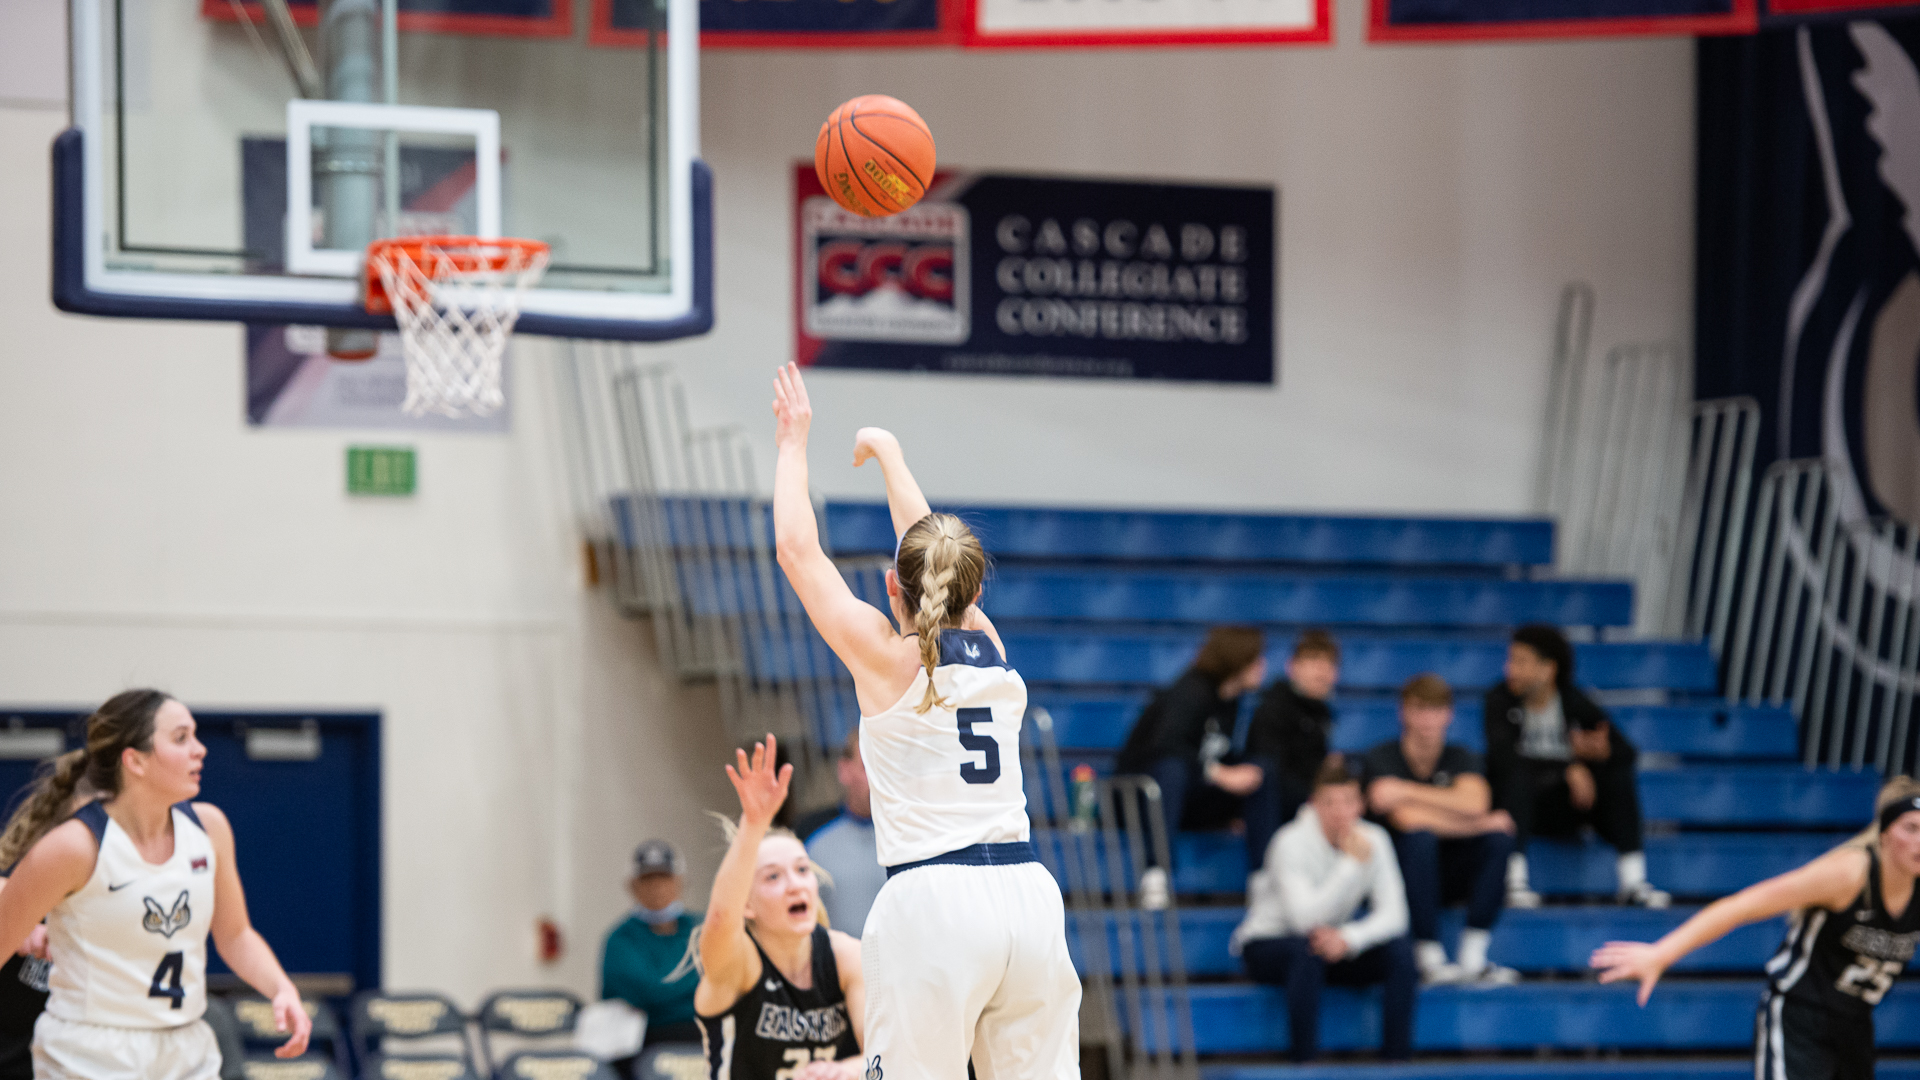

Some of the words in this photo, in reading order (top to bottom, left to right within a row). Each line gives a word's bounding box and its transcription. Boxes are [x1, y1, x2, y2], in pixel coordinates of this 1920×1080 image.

[997, 215, 1246, 262] CASCADE
[997, 257, 1246, 302] COLLEGIATE
[997, 299, 1246, 343] CONFERENCE
[956, 707, 1001, 784] 5
[148, 951, 185, 1009] 4
[1835, 955, 1903, 1005] 25
